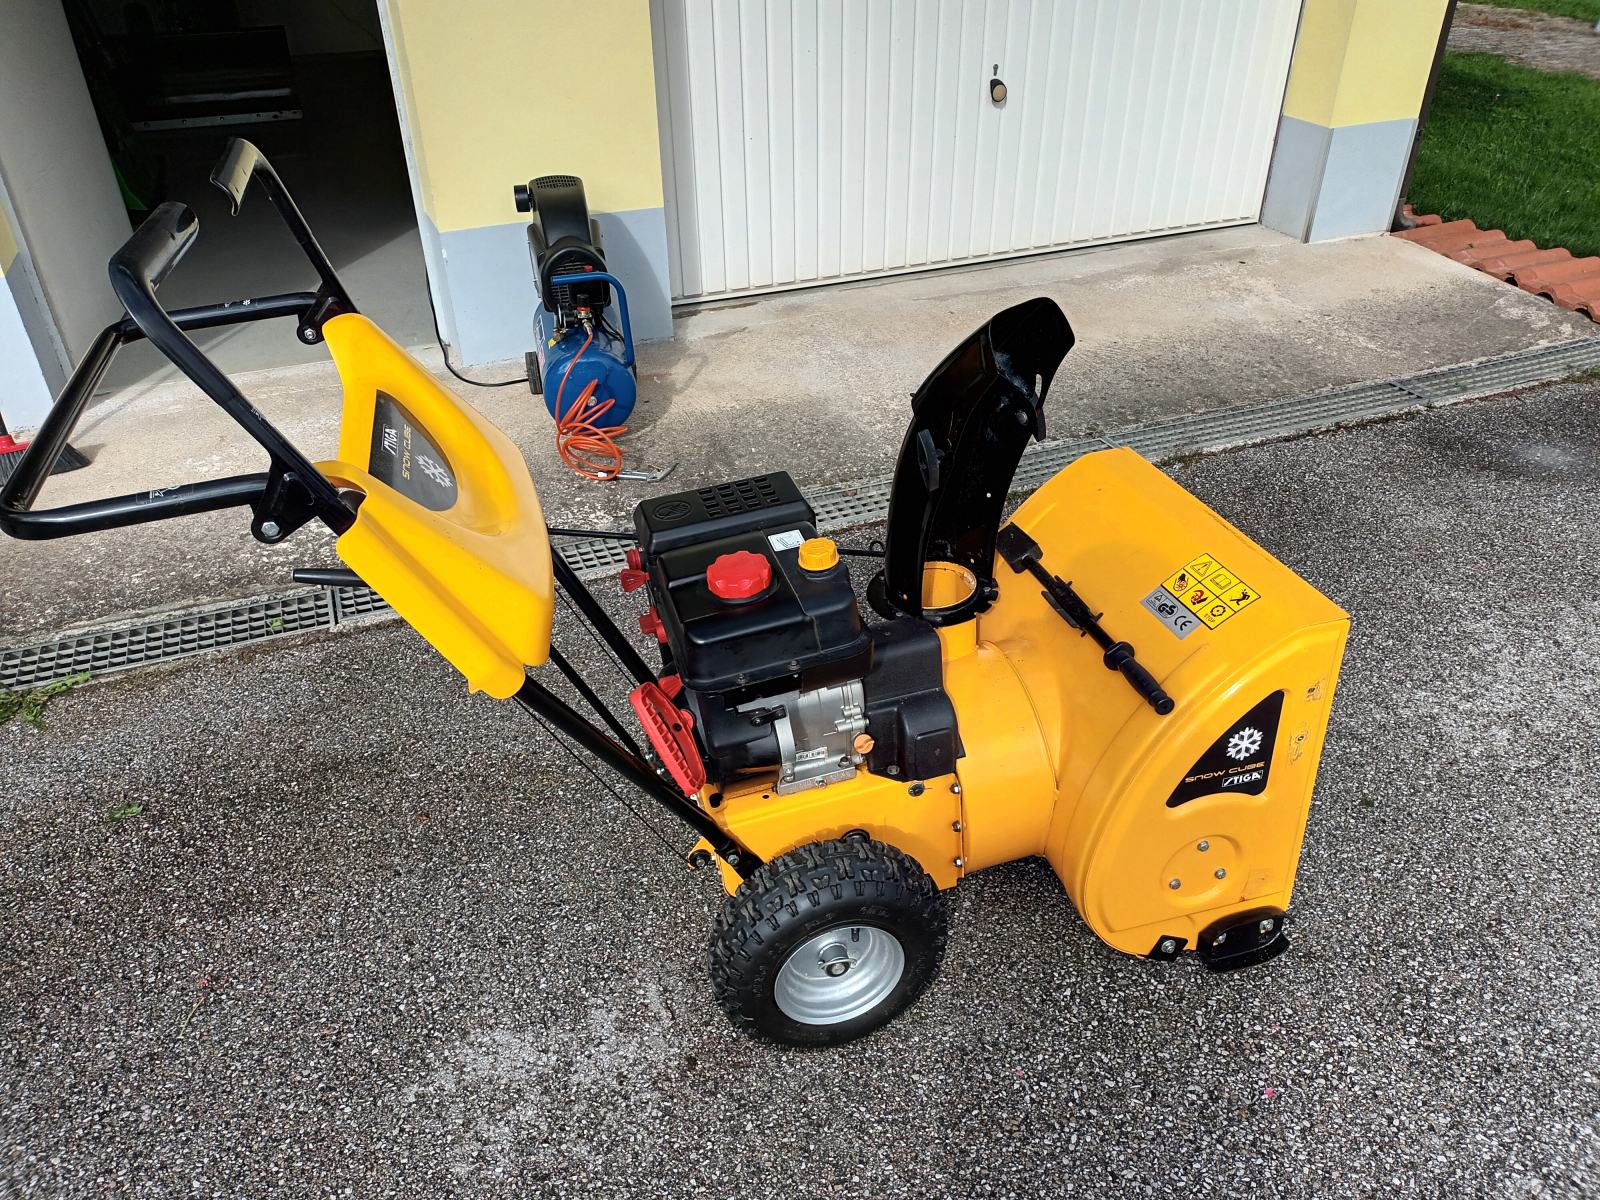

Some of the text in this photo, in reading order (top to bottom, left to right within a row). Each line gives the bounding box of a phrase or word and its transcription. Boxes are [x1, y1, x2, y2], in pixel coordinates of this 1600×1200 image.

[384, 428, 397, 456] STIGA
[402, 424, 411, 480] SNOW CUBE
[1158, 603, 1176, 615] GS
[1174, 615, 1193, 631] CE
[1185, 761, 1265, 783] SNOW CUBE
[1223, 772, 1261, 787] STIGA
